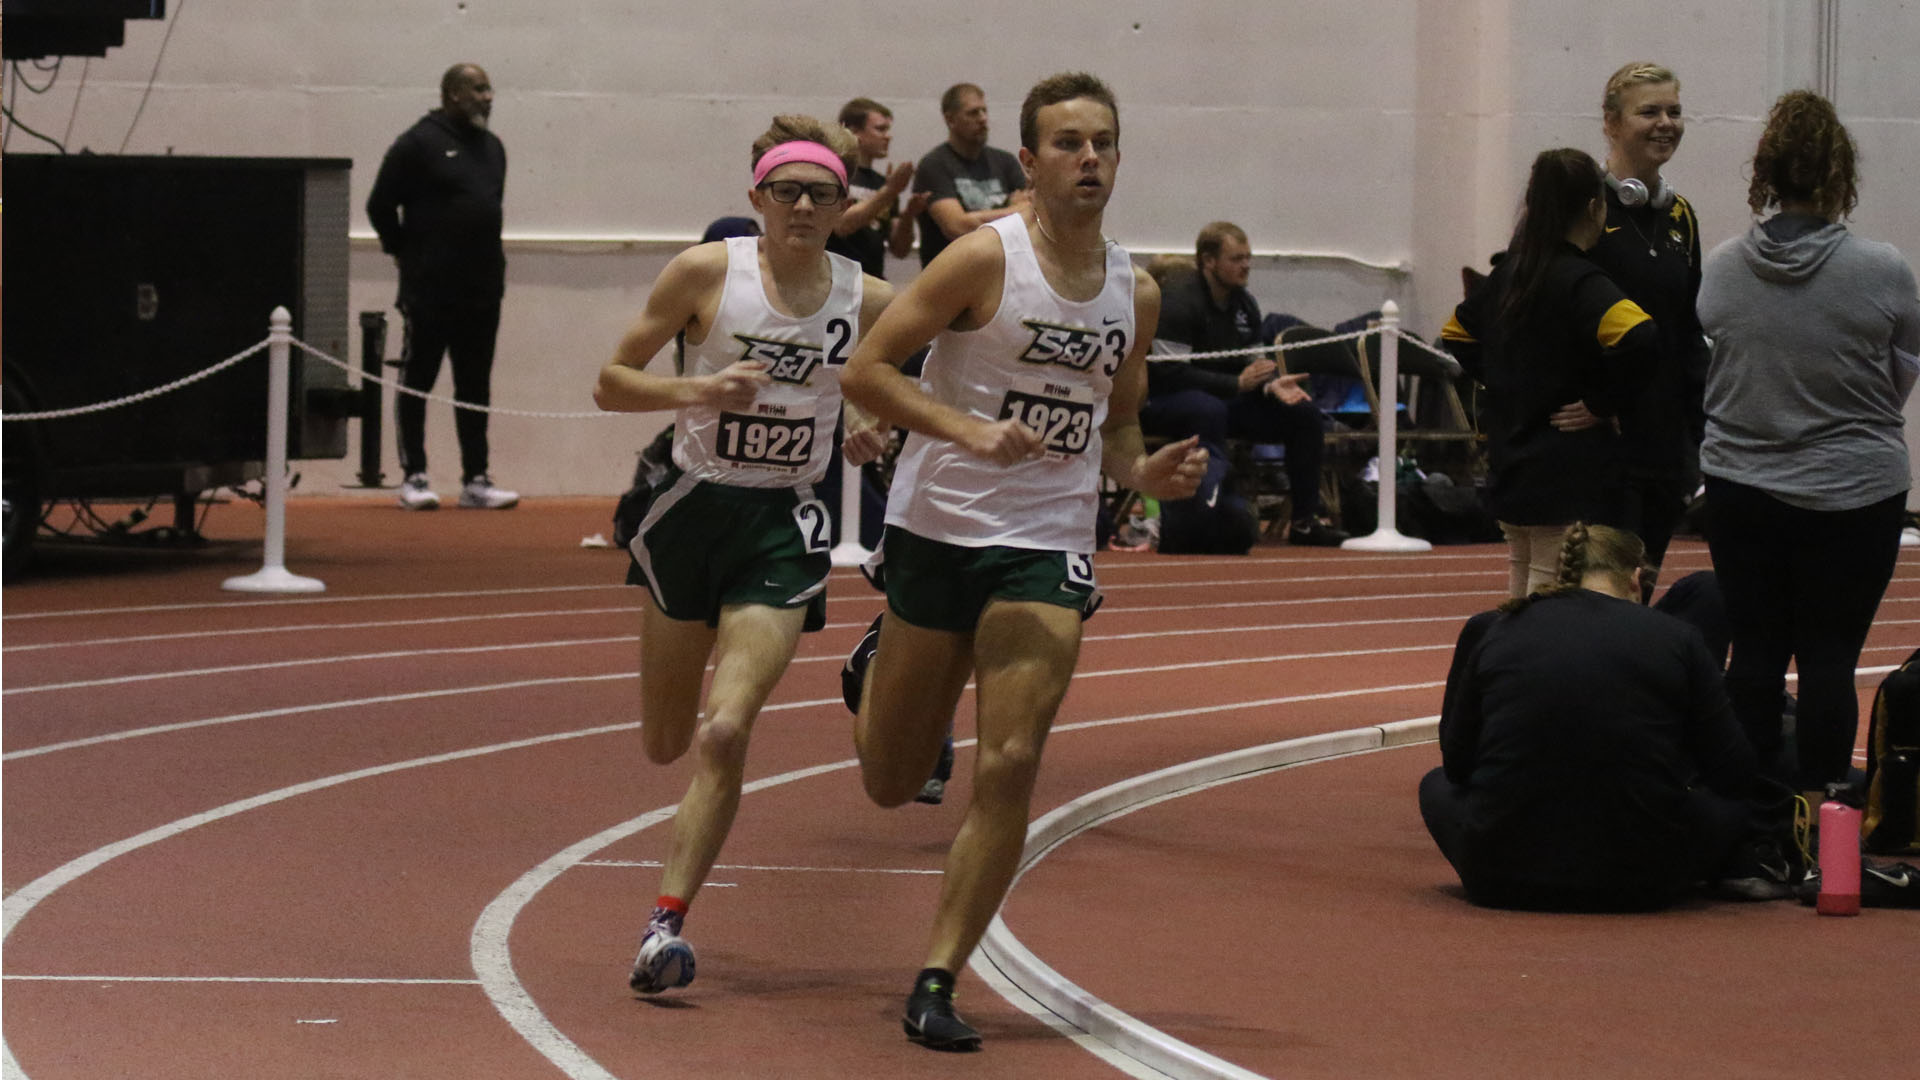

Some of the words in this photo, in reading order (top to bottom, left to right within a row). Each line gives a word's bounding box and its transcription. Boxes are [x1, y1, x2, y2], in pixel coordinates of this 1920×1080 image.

[826, 318, 852, 365] 2
[1103, 328, 1127, 377] 3
[724, 420, 812, 462] 1922
[1007, 400, 1091, 451] 1923
[799, 503, 830, 549] 2
